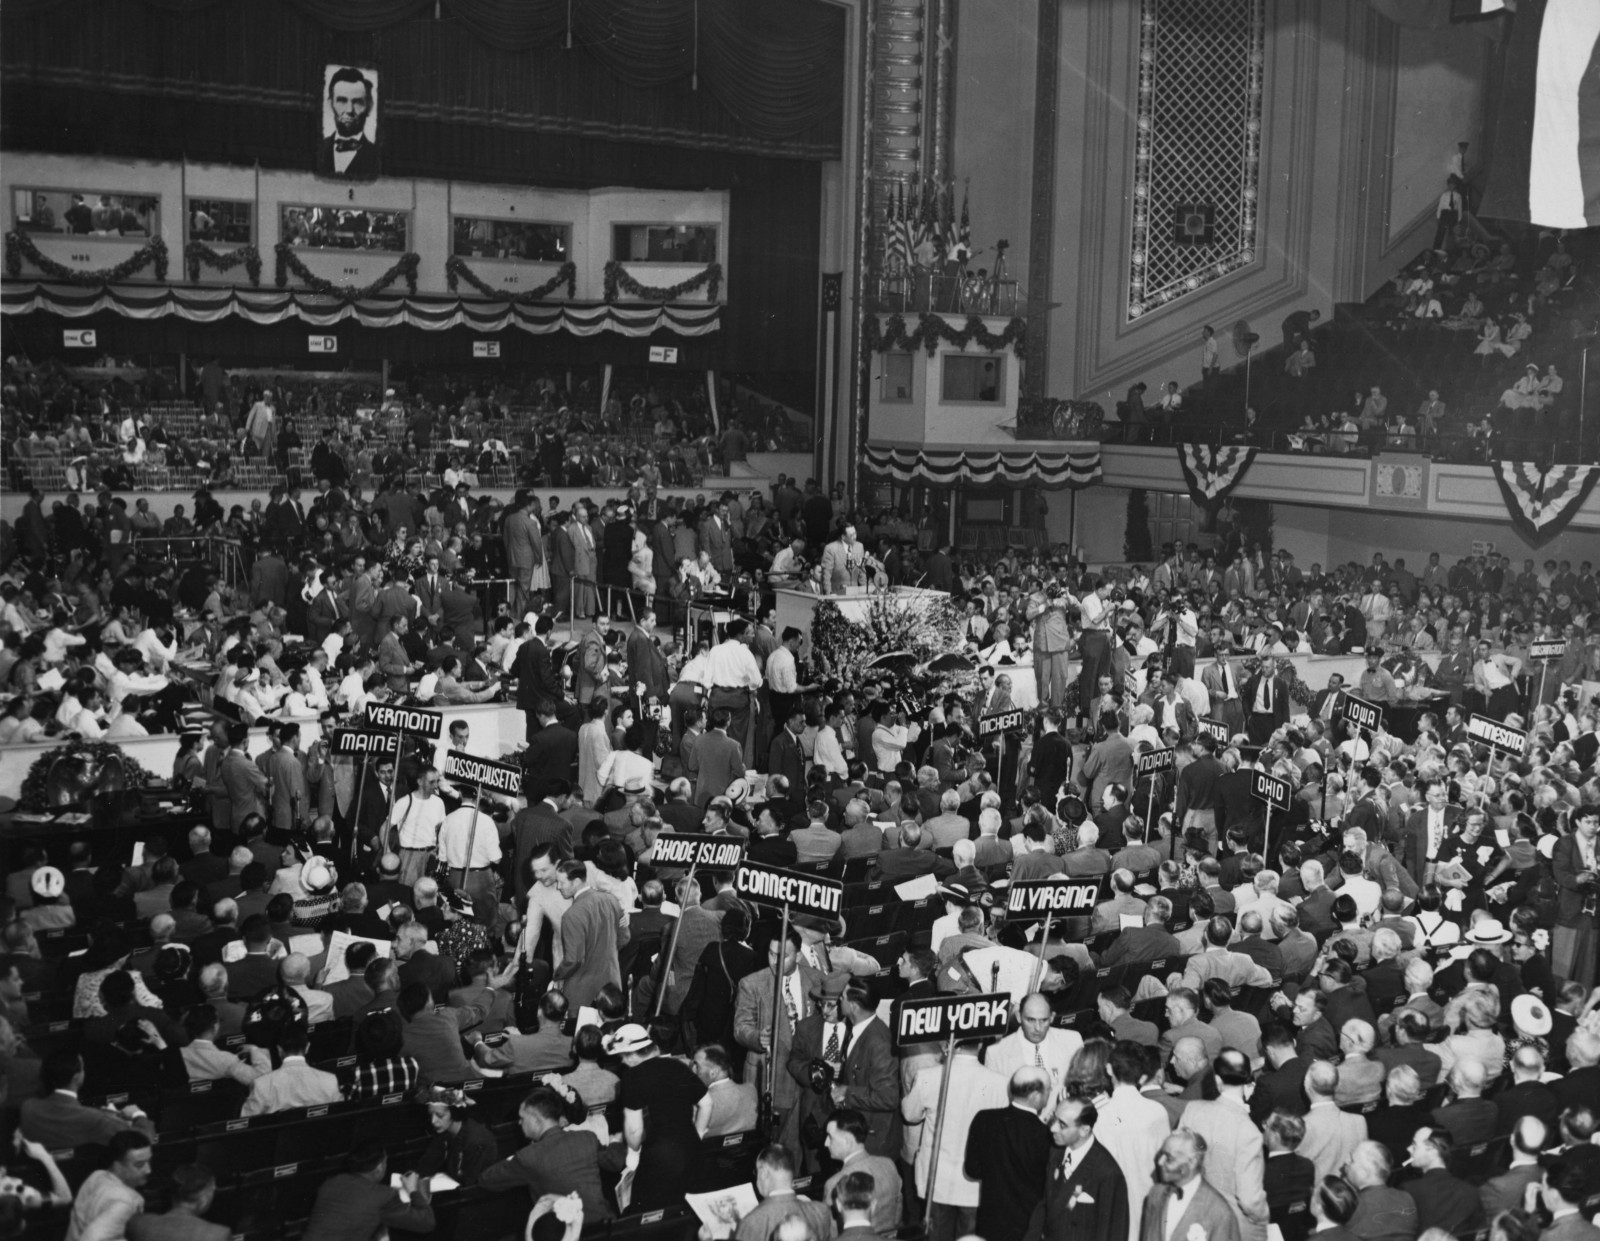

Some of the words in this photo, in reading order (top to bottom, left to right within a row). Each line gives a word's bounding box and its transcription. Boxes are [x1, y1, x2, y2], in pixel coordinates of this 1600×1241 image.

[80, 331, 93, 346] C
[323, 337, 335, 351] D
[487, 342, 497, 356] E
[663, 348, 674, 361] F
[367, 705, 440, 733] VERMONT
[980, 711, 1022, 735] MICHIGAN
[1348, 701, 1376, 727] IOWA
[340, 733, 397, 752] MAINE
[1469, 717, 1525, 752] MINNESOTA
[445, 755, 520, 792] MASSACHUSETTS
[1139, 750, 1173, 772] INDIANA
[1257, 775, 1284, 802] OHIO
[651, 838, 697, 863] RHODE
[696, 842, 741, 866] ISLAND
[737, 867, 842, 912] CONNECTICUT
[900, 1005, 942, 1037] NEW
[947, 999, 1010, 1031] YORK
